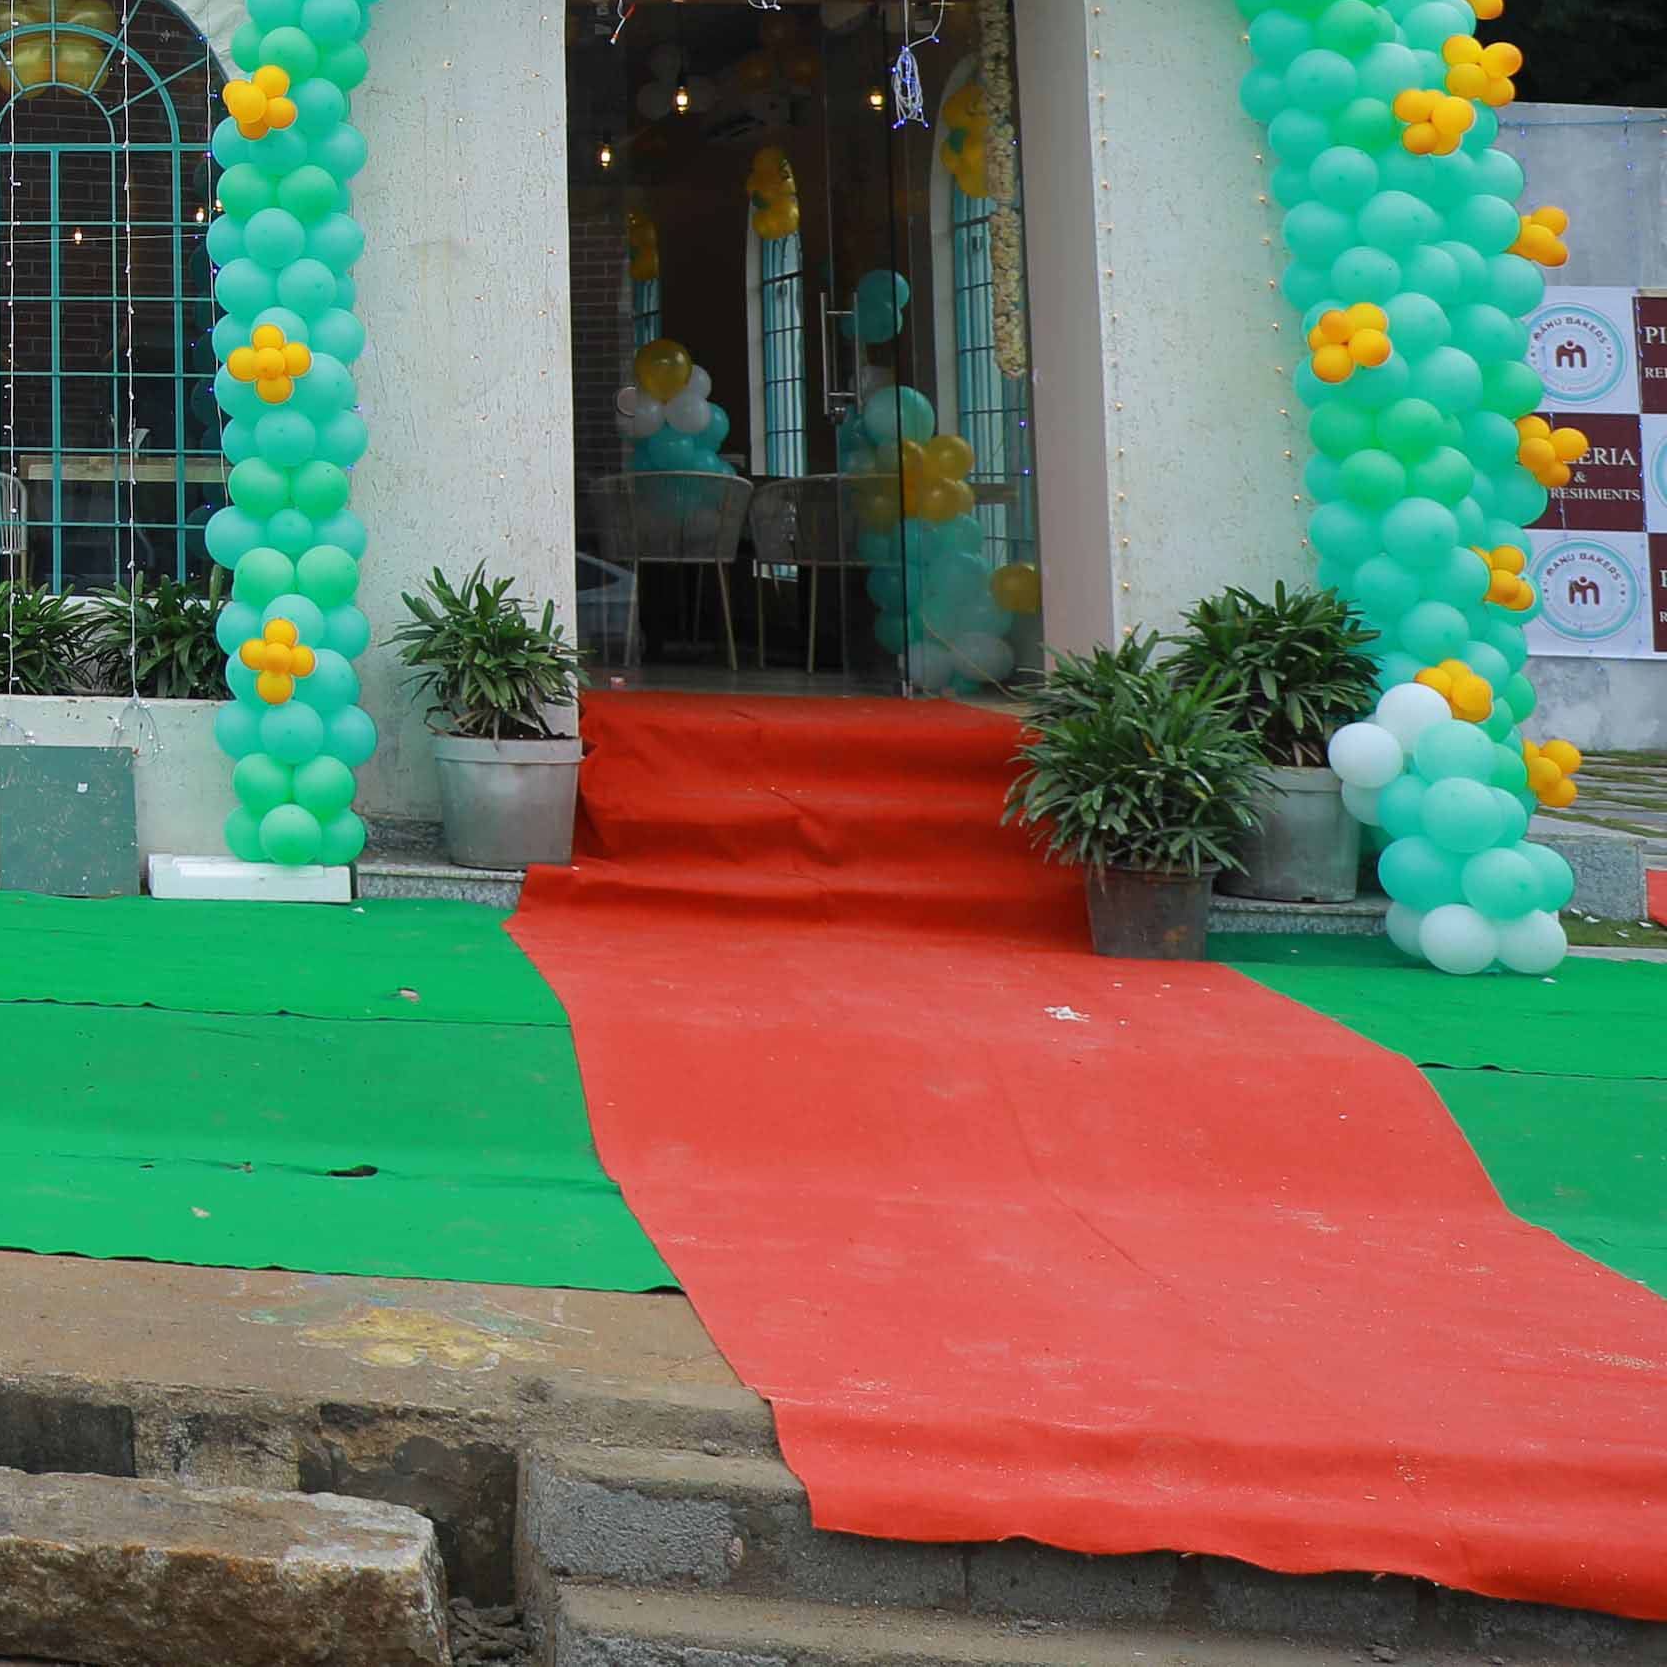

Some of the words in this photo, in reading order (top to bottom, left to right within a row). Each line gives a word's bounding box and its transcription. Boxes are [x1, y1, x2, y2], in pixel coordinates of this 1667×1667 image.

[1533, 317, 1563, 342] MANU
[1565, 316, 1608, 344] BAKERS
[1563, 447, 1637, 466] ERIA
[1573, 471, 1587, 483] &
[1549, 487, 1641, 501] RESHMENTS
[1546, 553, 1576, 577] MANU
[1579, 552, 1621, 581] BAKERS
